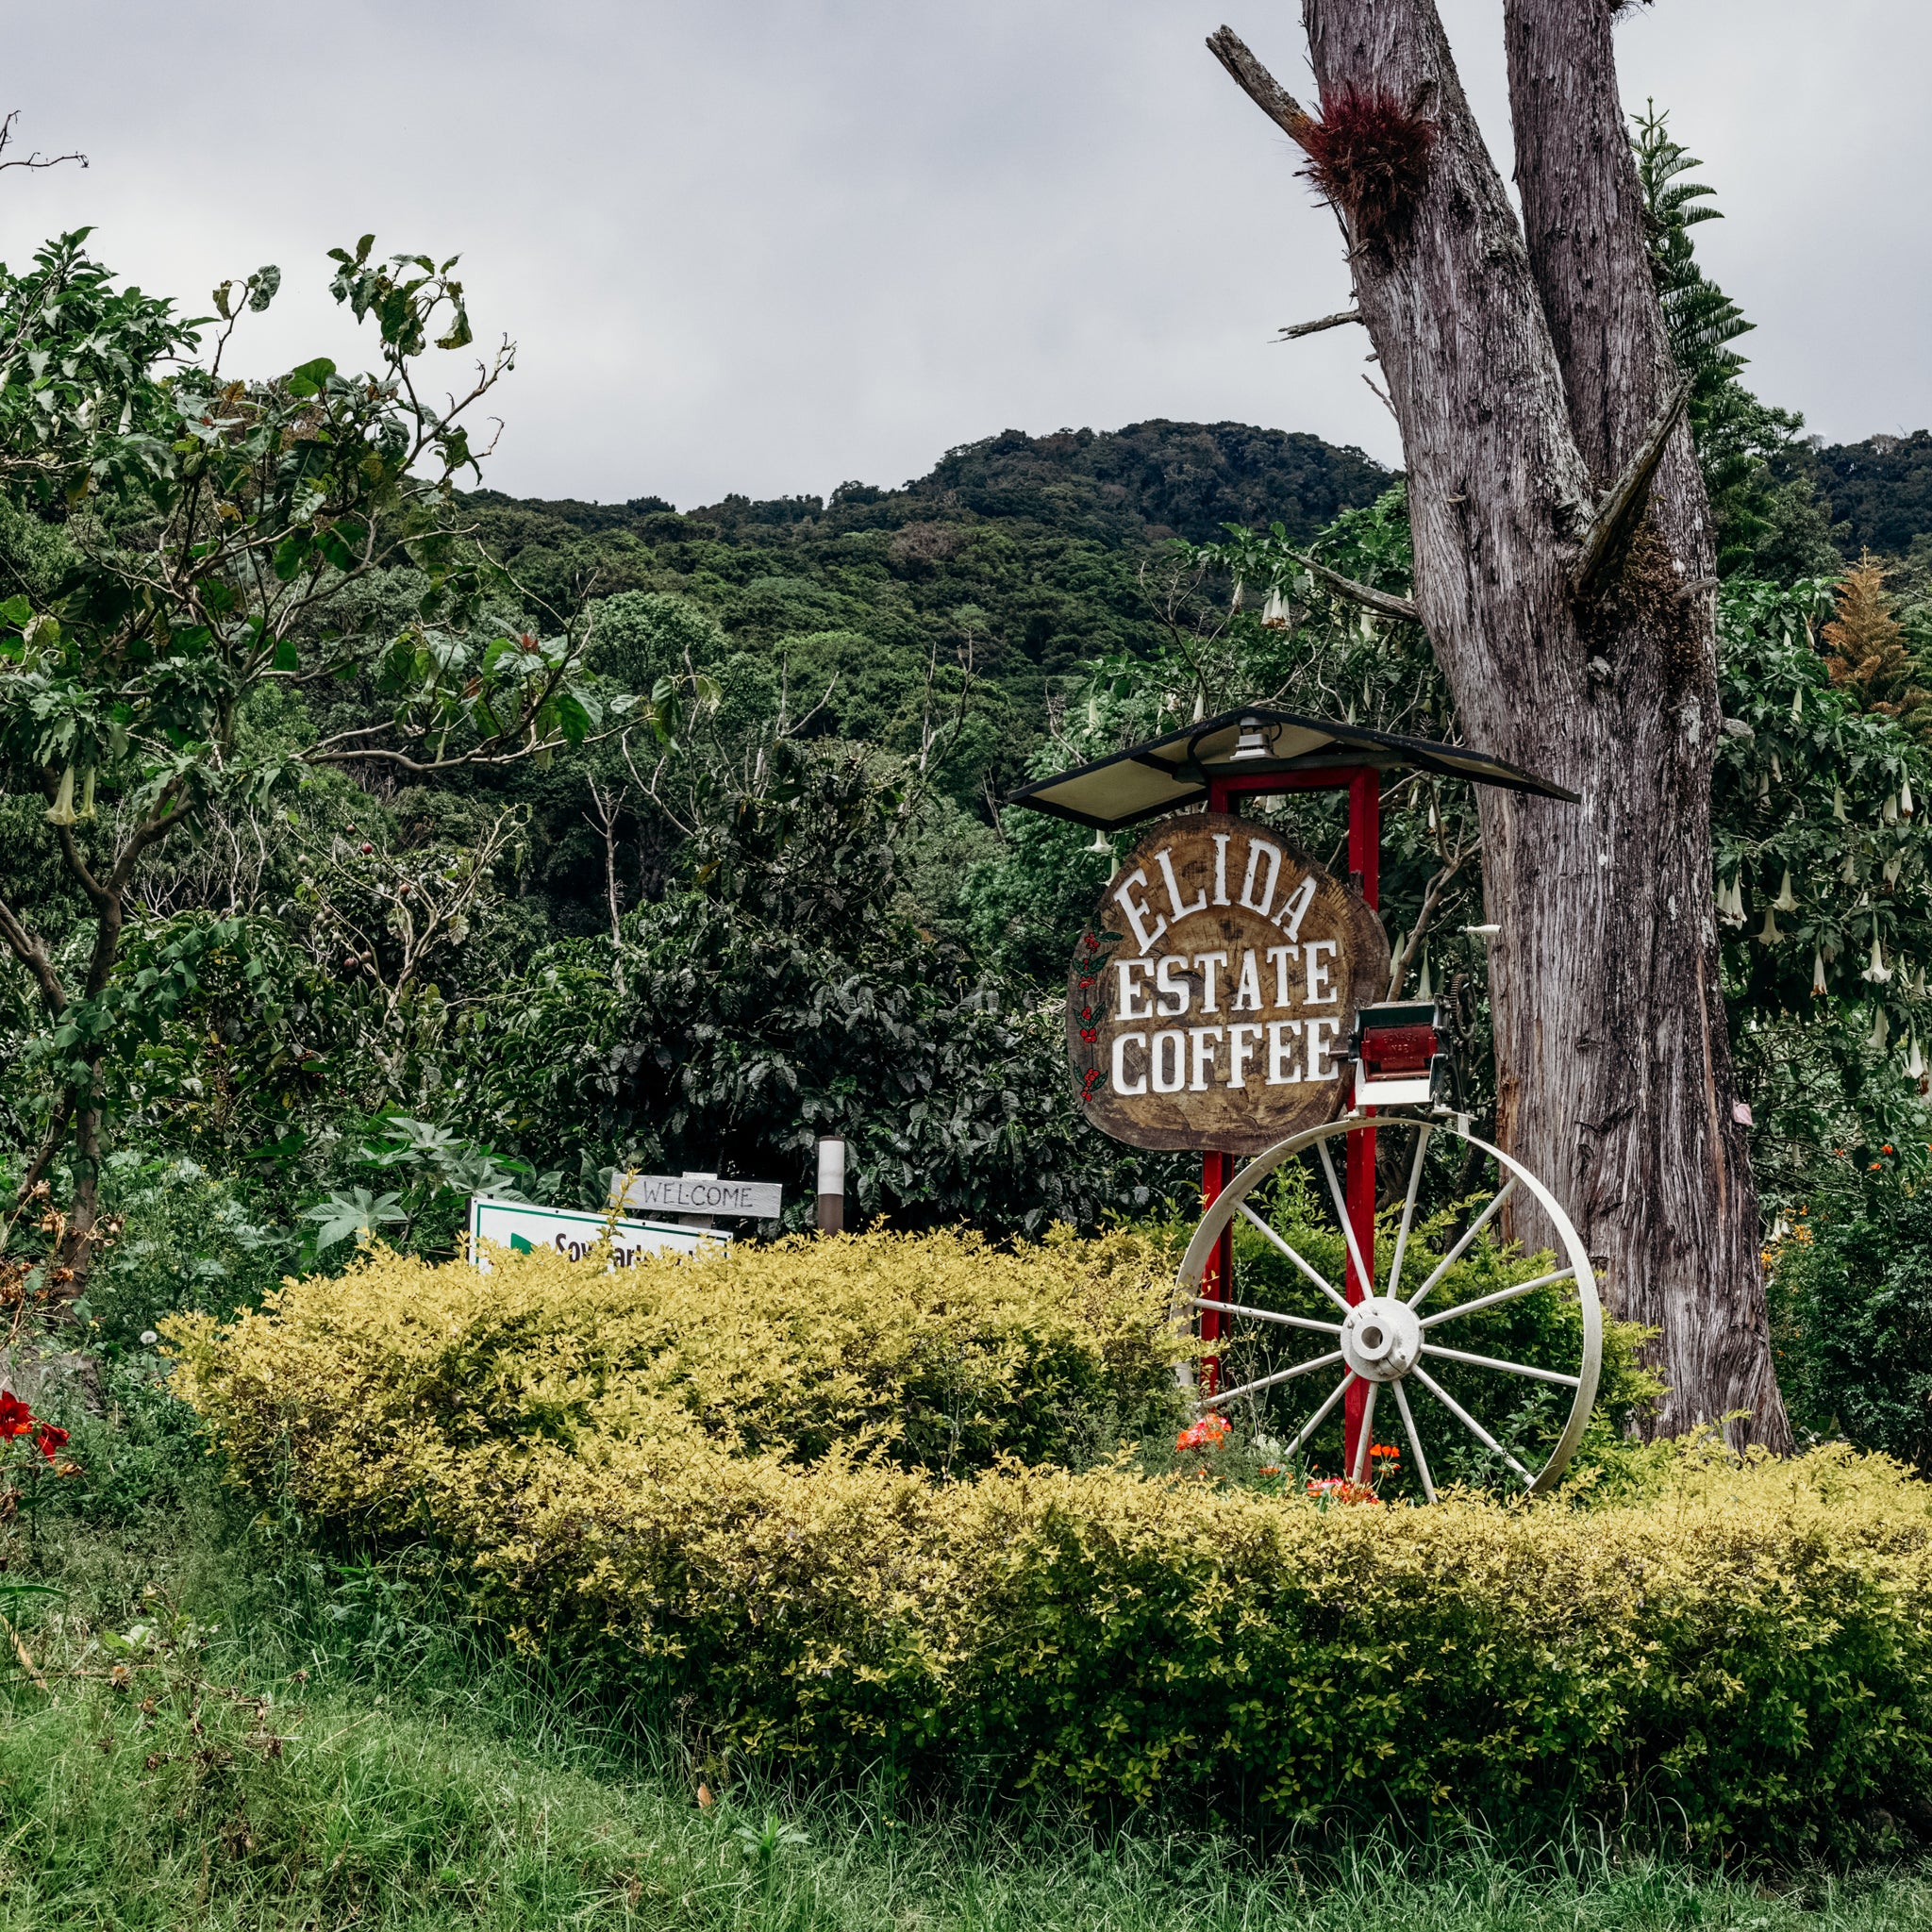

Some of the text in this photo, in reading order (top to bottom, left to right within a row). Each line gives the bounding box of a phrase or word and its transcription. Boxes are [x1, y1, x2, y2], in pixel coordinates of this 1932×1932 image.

[1113, 833, 1319, 957] ELIDA
[1113, 940, 1339, 1022] ESTATE
[1111, 1016, 1341, 1096] COFFEE
[643, 1180, 753, 1208] WELCOME
